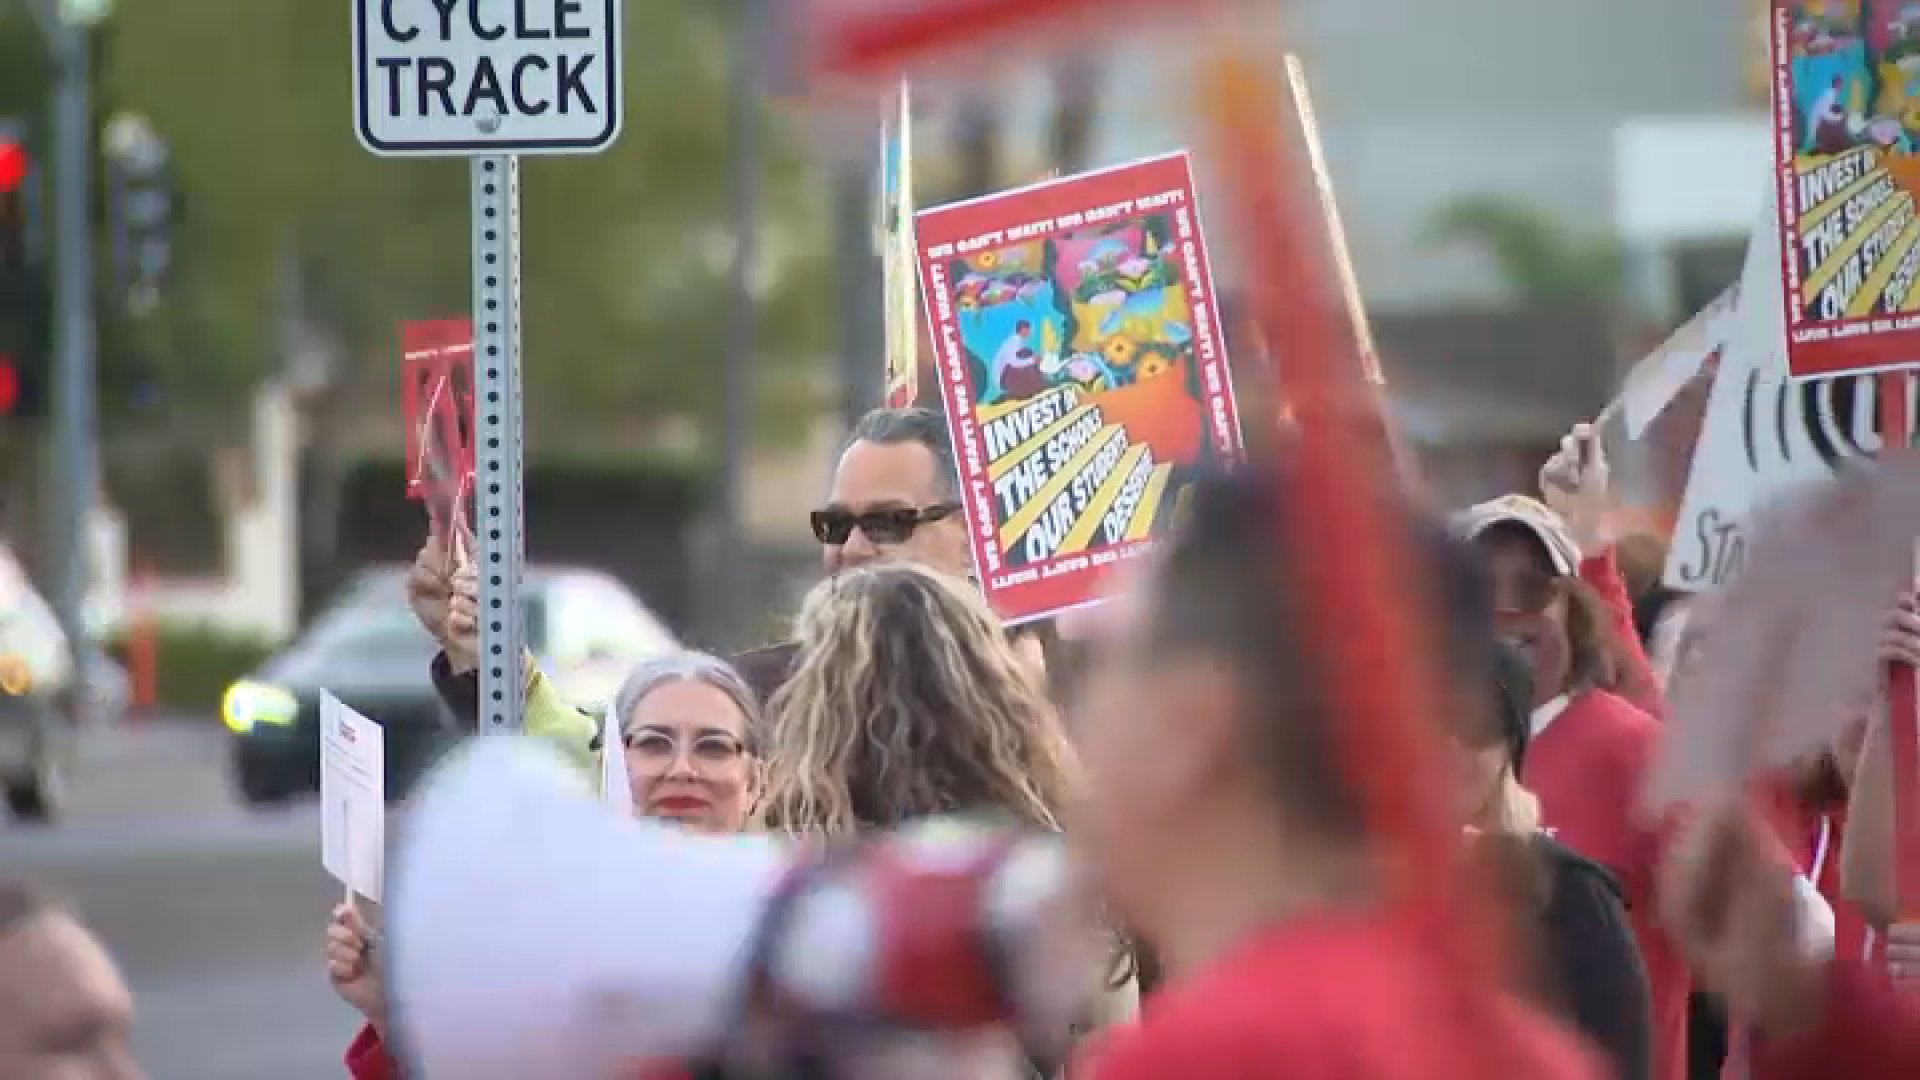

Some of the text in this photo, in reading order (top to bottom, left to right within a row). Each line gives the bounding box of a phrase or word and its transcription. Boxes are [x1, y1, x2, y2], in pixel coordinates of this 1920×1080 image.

[380, 0, 591, 42] CYCLE
[376, 53, 598, 117] TRACK
[983, 391, 1062, 461] INVEST
[993, 450, 1048, 518] THE
[1025, 490, 1074, 564] OUR
